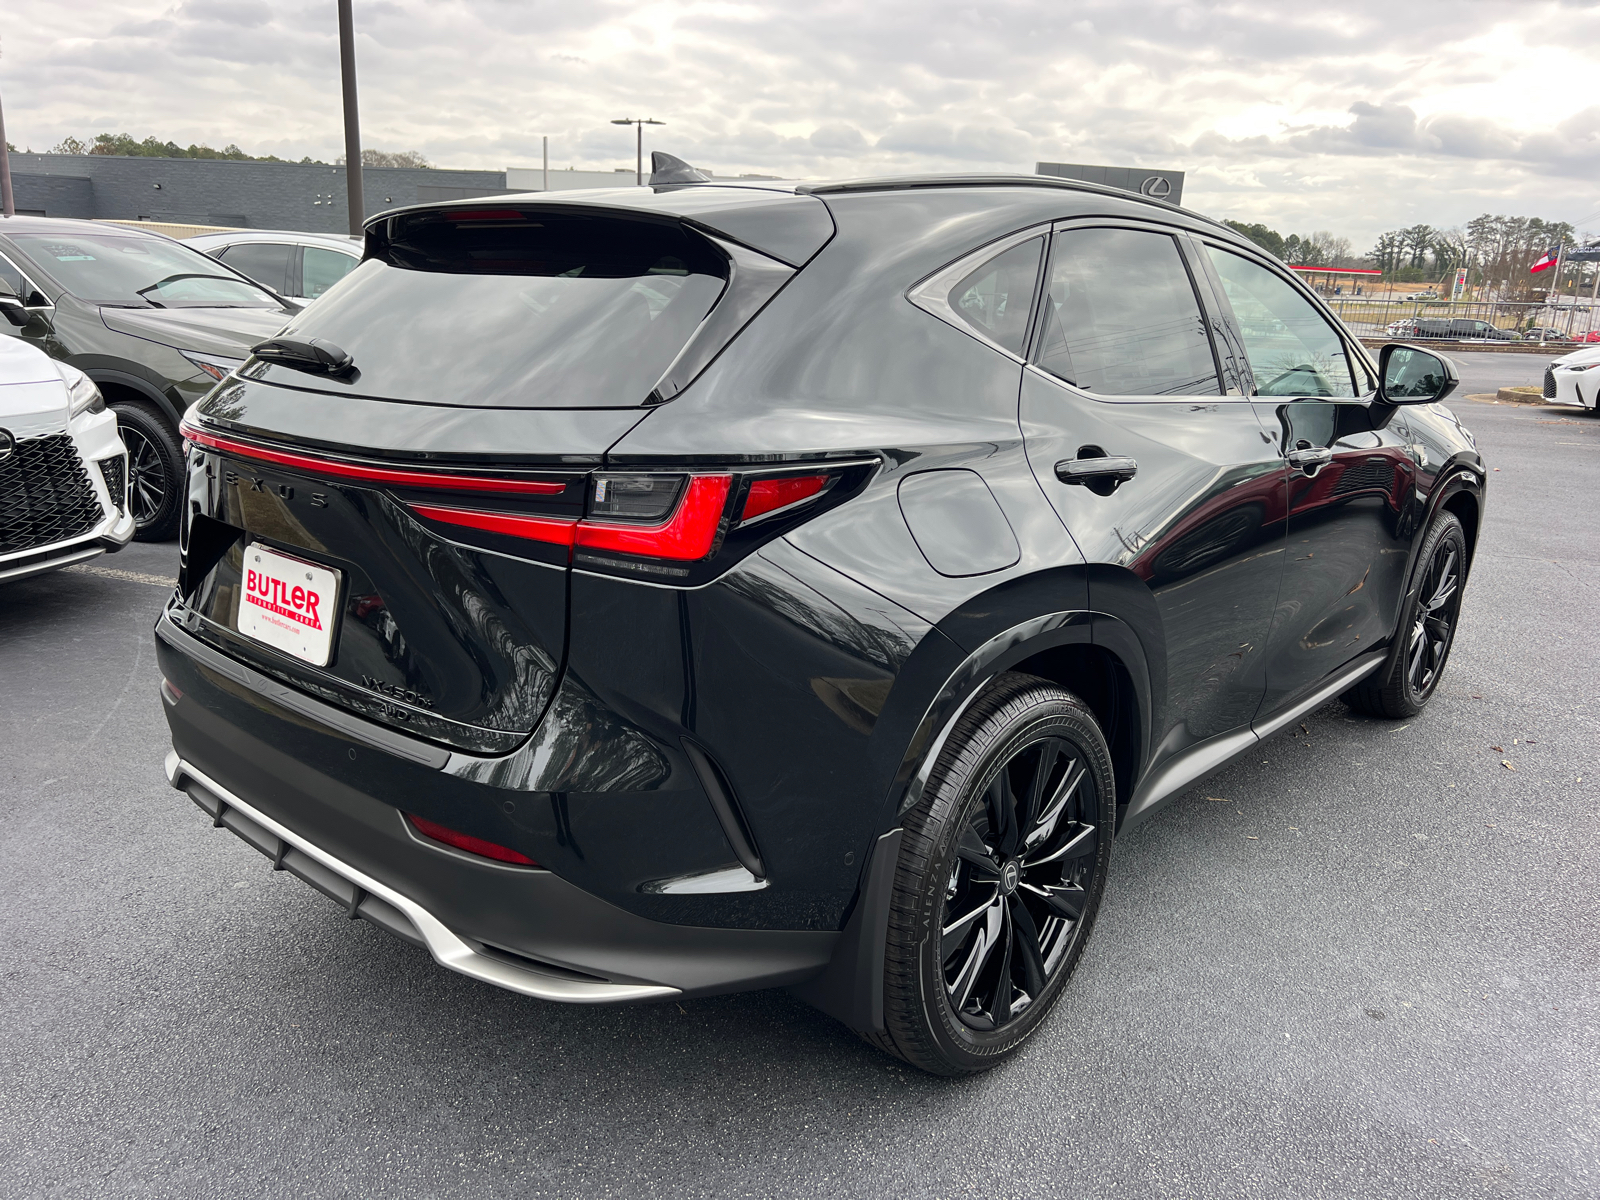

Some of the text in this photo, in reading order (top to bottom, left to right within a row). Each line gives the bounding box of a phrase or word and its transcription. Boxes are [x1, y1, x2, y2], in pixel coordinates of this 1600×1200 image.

[205, 465, 328, 508] LEXUS
[246, 595, 320, 629] AUTOMOTIVE GROUP
[922, 863, 941, 928] ALENZA
